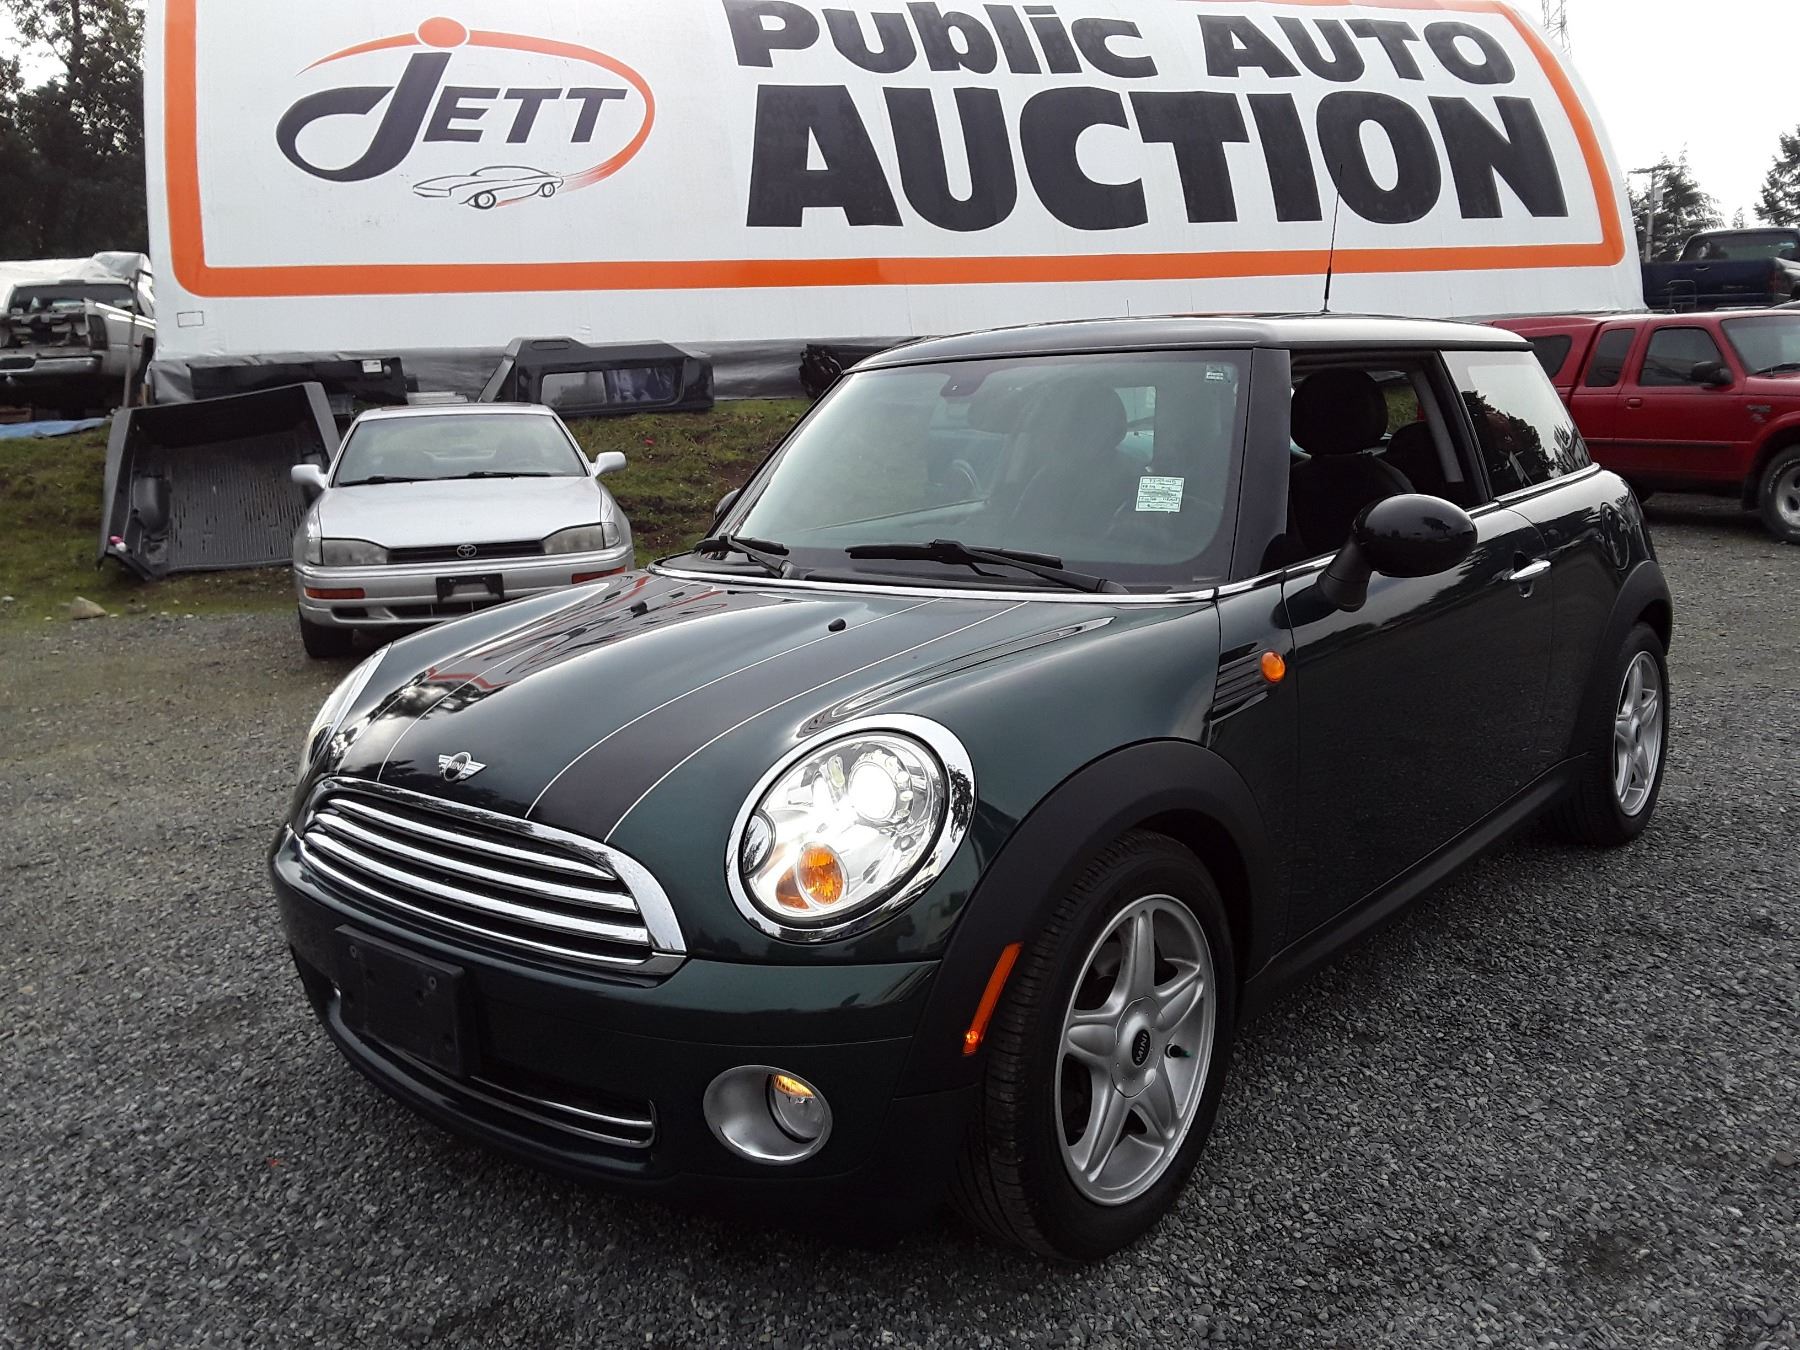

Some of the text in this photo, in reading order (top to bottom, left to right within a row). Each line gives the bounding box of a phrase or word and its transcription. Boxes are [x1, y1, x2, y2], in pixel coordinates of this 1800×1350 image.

[1197, 14, 1516, 84] AUTO
[276, 51, 628, 182] JETT
[746, 84, 1569, 231] AUCTION
[1136, 1032, 1148, 1062] MINI
